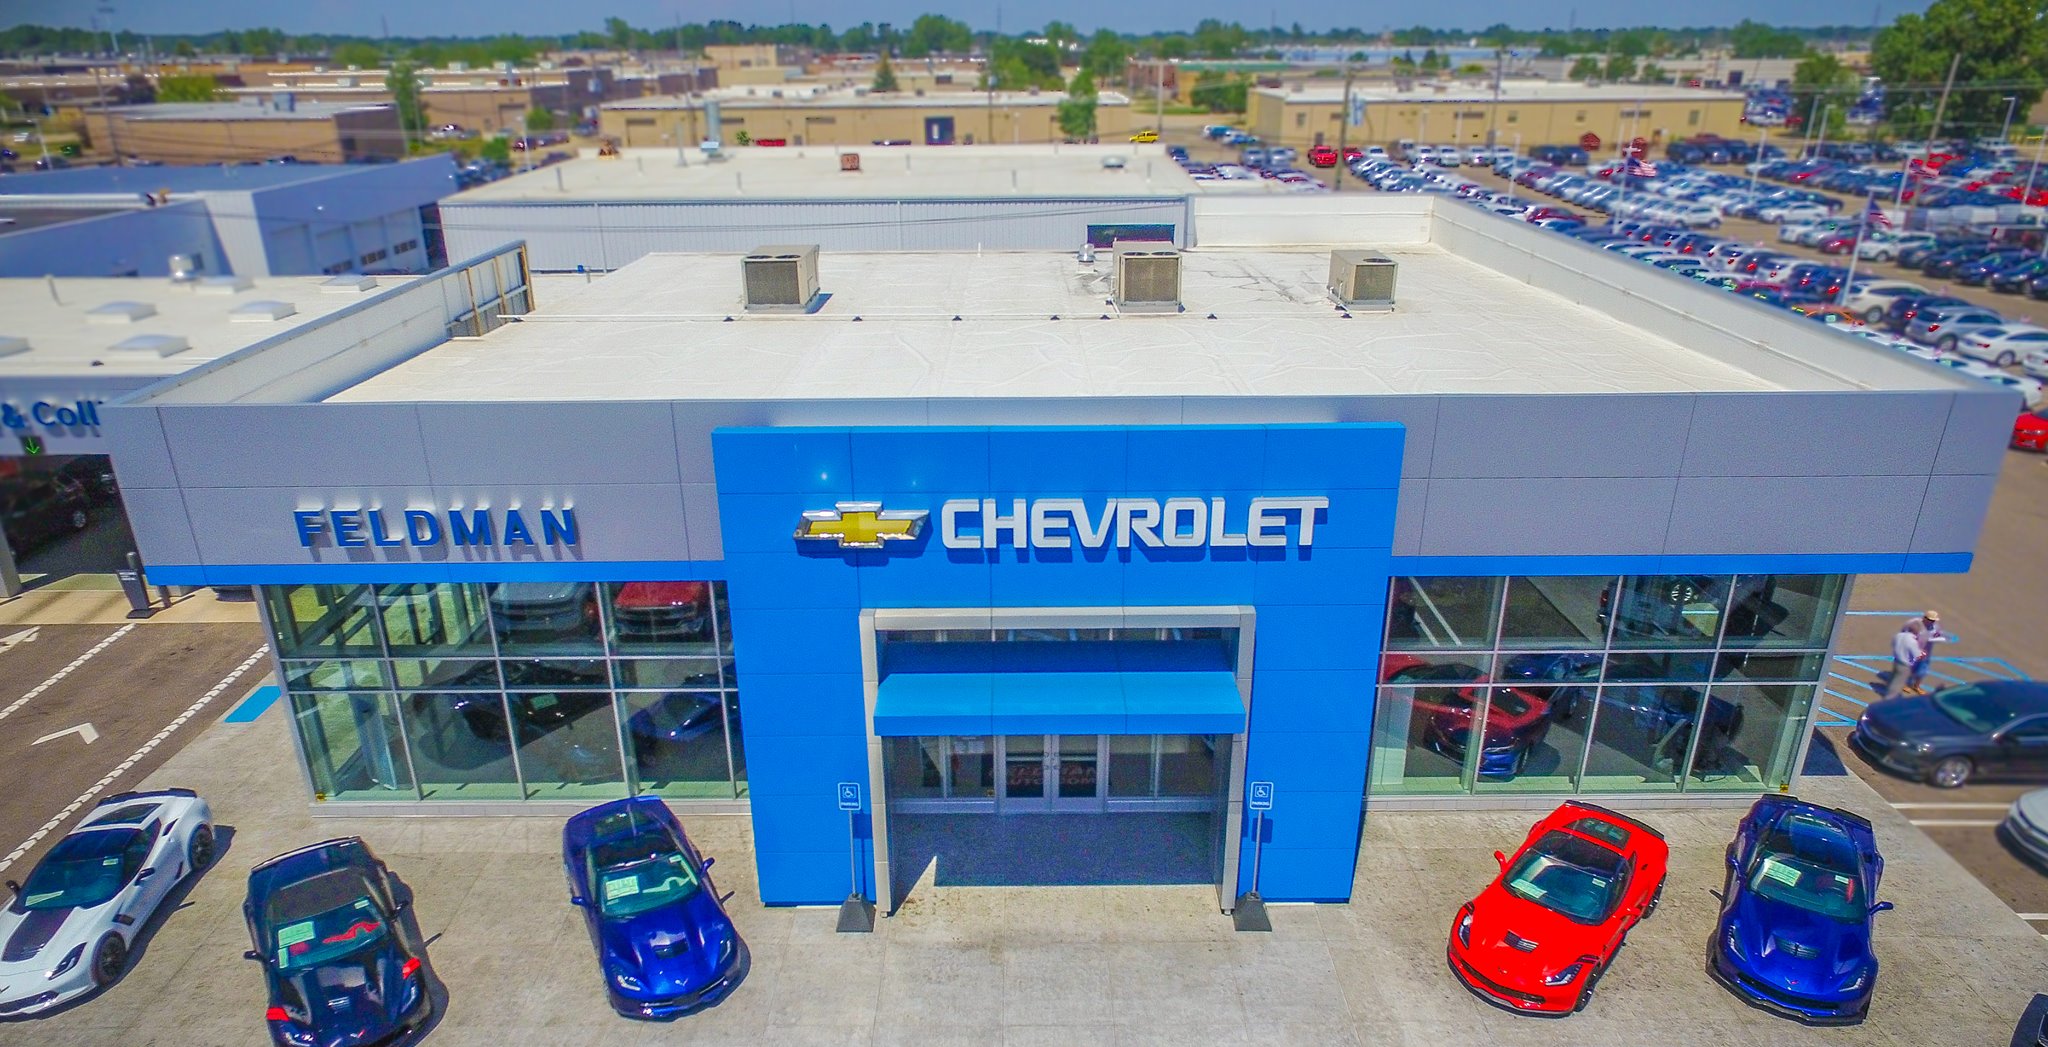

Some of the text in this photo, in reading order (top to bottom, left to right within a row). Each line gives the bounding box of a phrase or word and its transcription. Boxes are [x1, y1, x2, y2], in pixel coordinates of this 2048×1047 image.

[1, 400, 103, 429] & Coll
[293, 507, 579, 548] FELDMAN
[941, 496, 1330, 549] CHEVROLET
